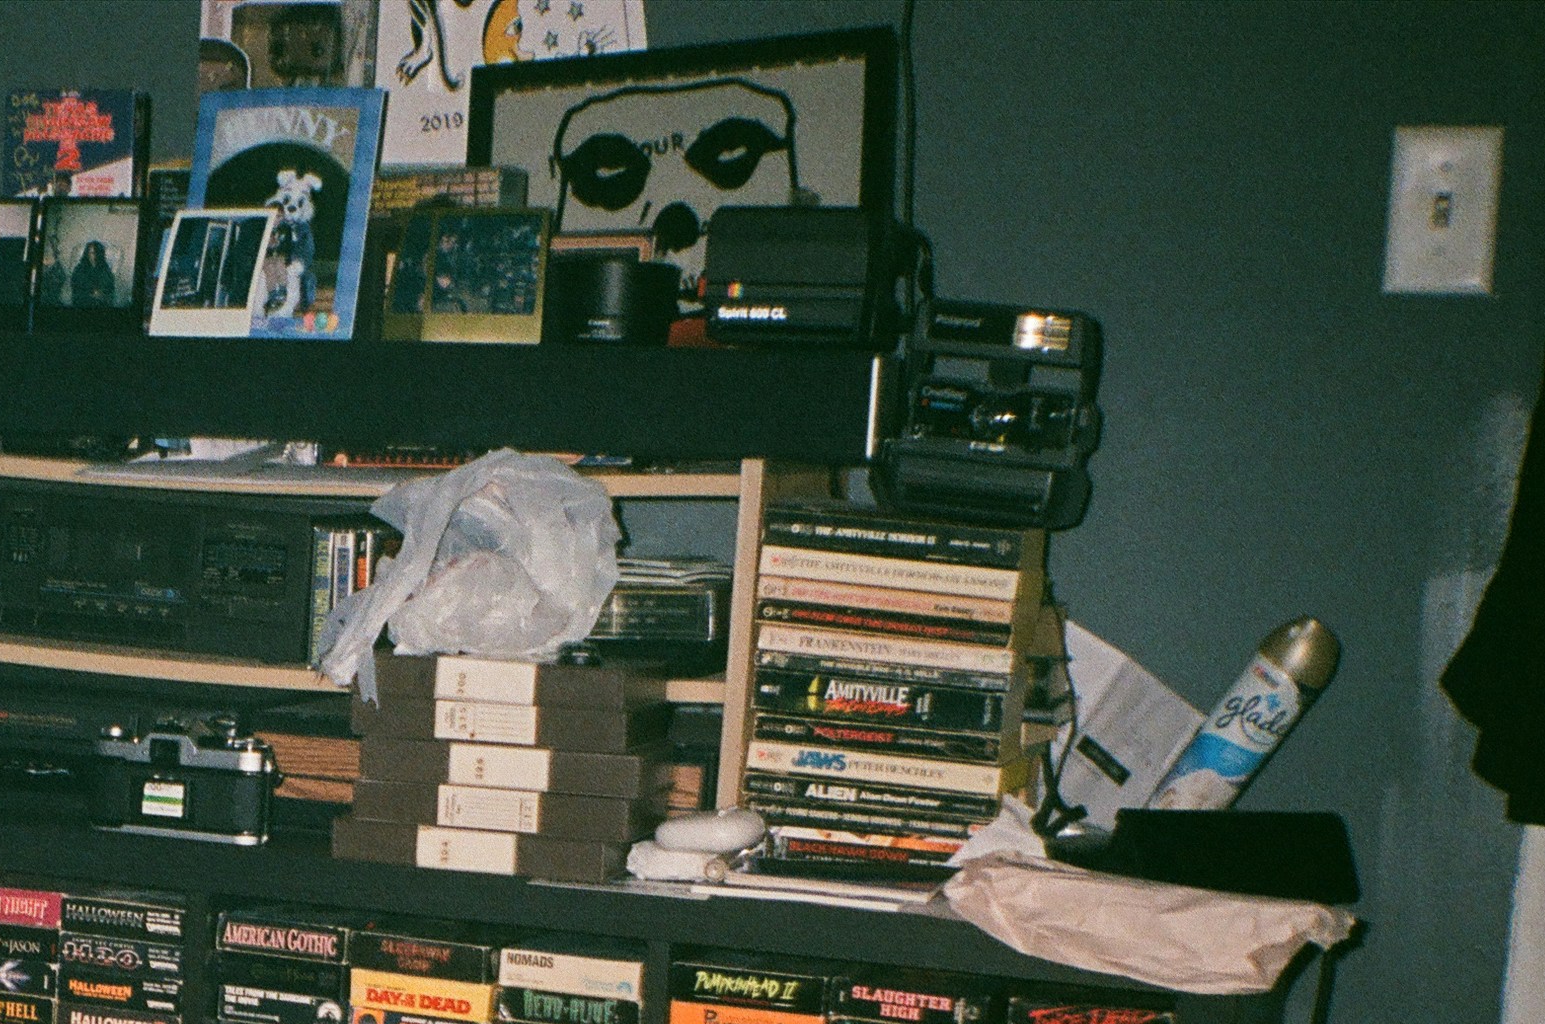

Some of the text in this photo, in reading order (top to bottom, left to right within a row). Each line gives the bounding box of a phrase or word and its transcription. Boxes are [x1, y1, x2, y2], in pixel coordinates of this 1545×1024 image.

[404, 108, 438, 125] 2019
[54, 148, 81, 170] 2
[824, 678, 909, 705] AMITYVILLE
[813, 726, 894, 743] POLTERGEIST
[792, 749, 847, 771] JAWS
[804, 784, 857, 802] ALIEN
[222, 921, 338, 957] AMERICAN GOTHIC
[506, 952, 555, 970] NOMADS
[366, 987, 471, 1017] DAY DEAD
[851, 984, 953, 1022] SLAUGHTER HIGH
